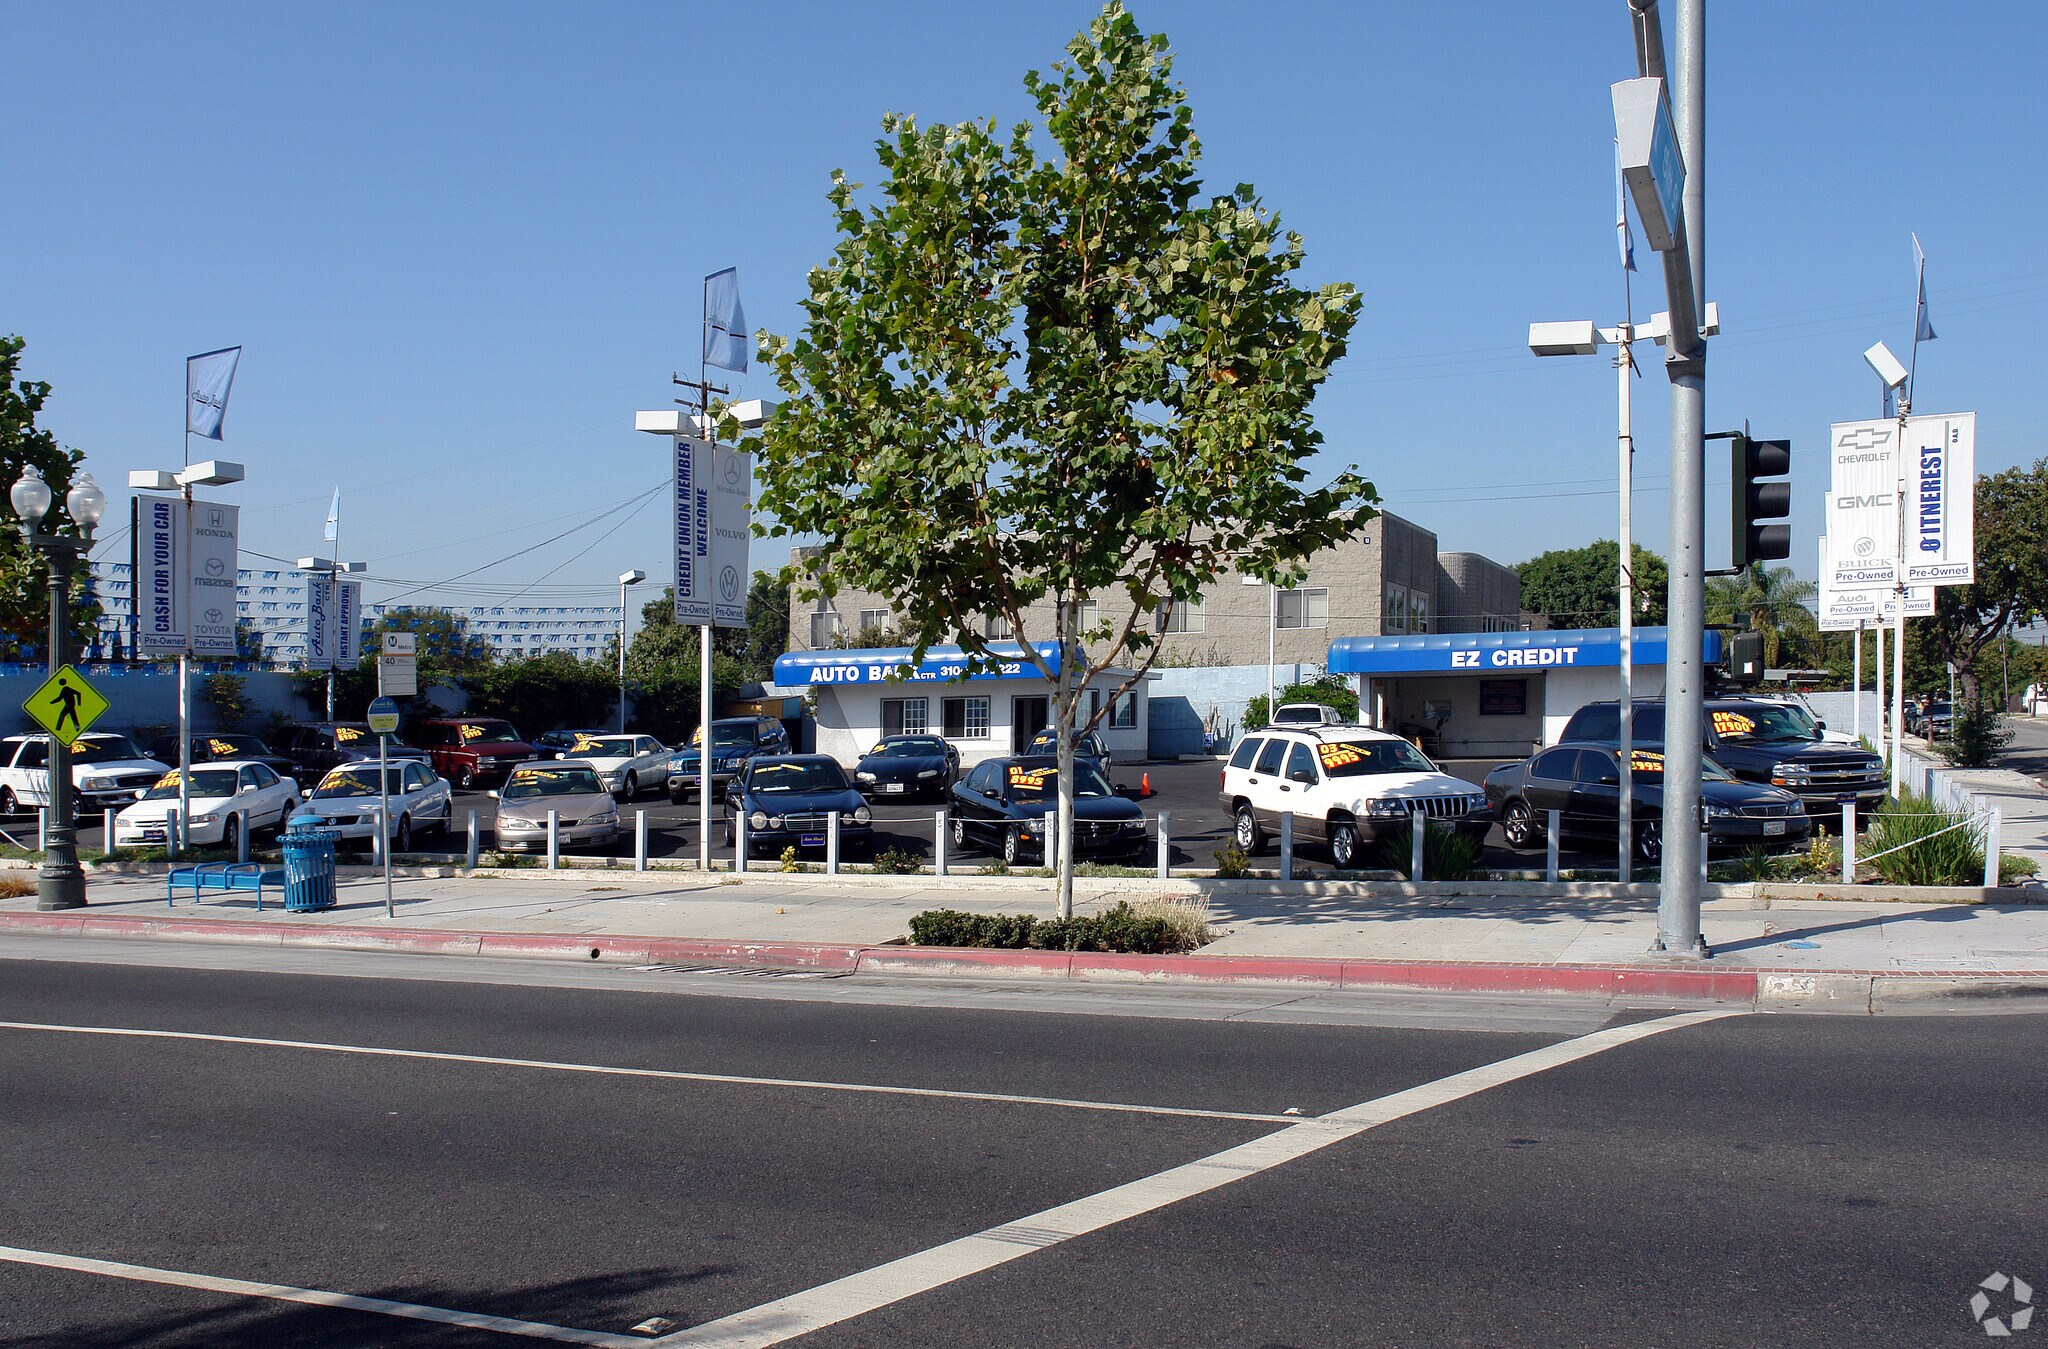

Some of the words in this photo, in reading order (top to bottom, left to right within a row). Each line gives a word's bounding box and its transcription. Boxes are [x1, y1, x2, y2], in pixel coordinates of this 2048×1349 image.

[1838, 451, 1892, 464] CHEVROLET
[678, 442, 691, 501] MEMBER
[1919, 445, 1942, 534] ITNEREST
[1837, 493, 1892, 510] GMC
[153, 503, 170, 530] CAR
[696, 487, 708, 557] WELCOME
[678, 503, 691, 546] UNION
[195, 528, 235, 539] HONDA
[715, 527, 747, 541] VOLVO
[154, 532, 170, 567] YOUR
[1838, 558, 1893, 569] BUICK
[678, 548, 691, 598] CREDIT
[1835, 570, 1894, 581] Pre-Owned
[1909, 566, 1969, 578] Pre-Owned
[154, 570, 170, 594] FOR
[311, 581, 326, 621] Bank
[340, 585, 350, 624] APPROVAL
[678, 604, 710, 615] Pre-Owned
[716, 607, 743, 618] Pre-Owned
[1830, 605, 1875, 614] Pre-Owned
[195, 624, 232, 635] TOYOTA
[144, 636, 187, 646] Pre-Owned
[194, 638, 234, 648] Pre-Owned
[311, 619, 324, 657] Auto
[340, 626, 349, 659] INSTANT
[385, 657, 396, 665] 40
[1451, 650, 1481, 668] EZ
[1491, 647, 1579, 667] CREDIT
[809, 666, 860, 683] AUTO
[868, 664, 921, 682] BAK
[920, 671, 937, 680] CTR
[1320, 743, 1338, 755] 03
[1323, 751, 1360, 768] 9995
[1009, 766, 1024, 775] 01
[1010, 774, 1045, 786] 8995
